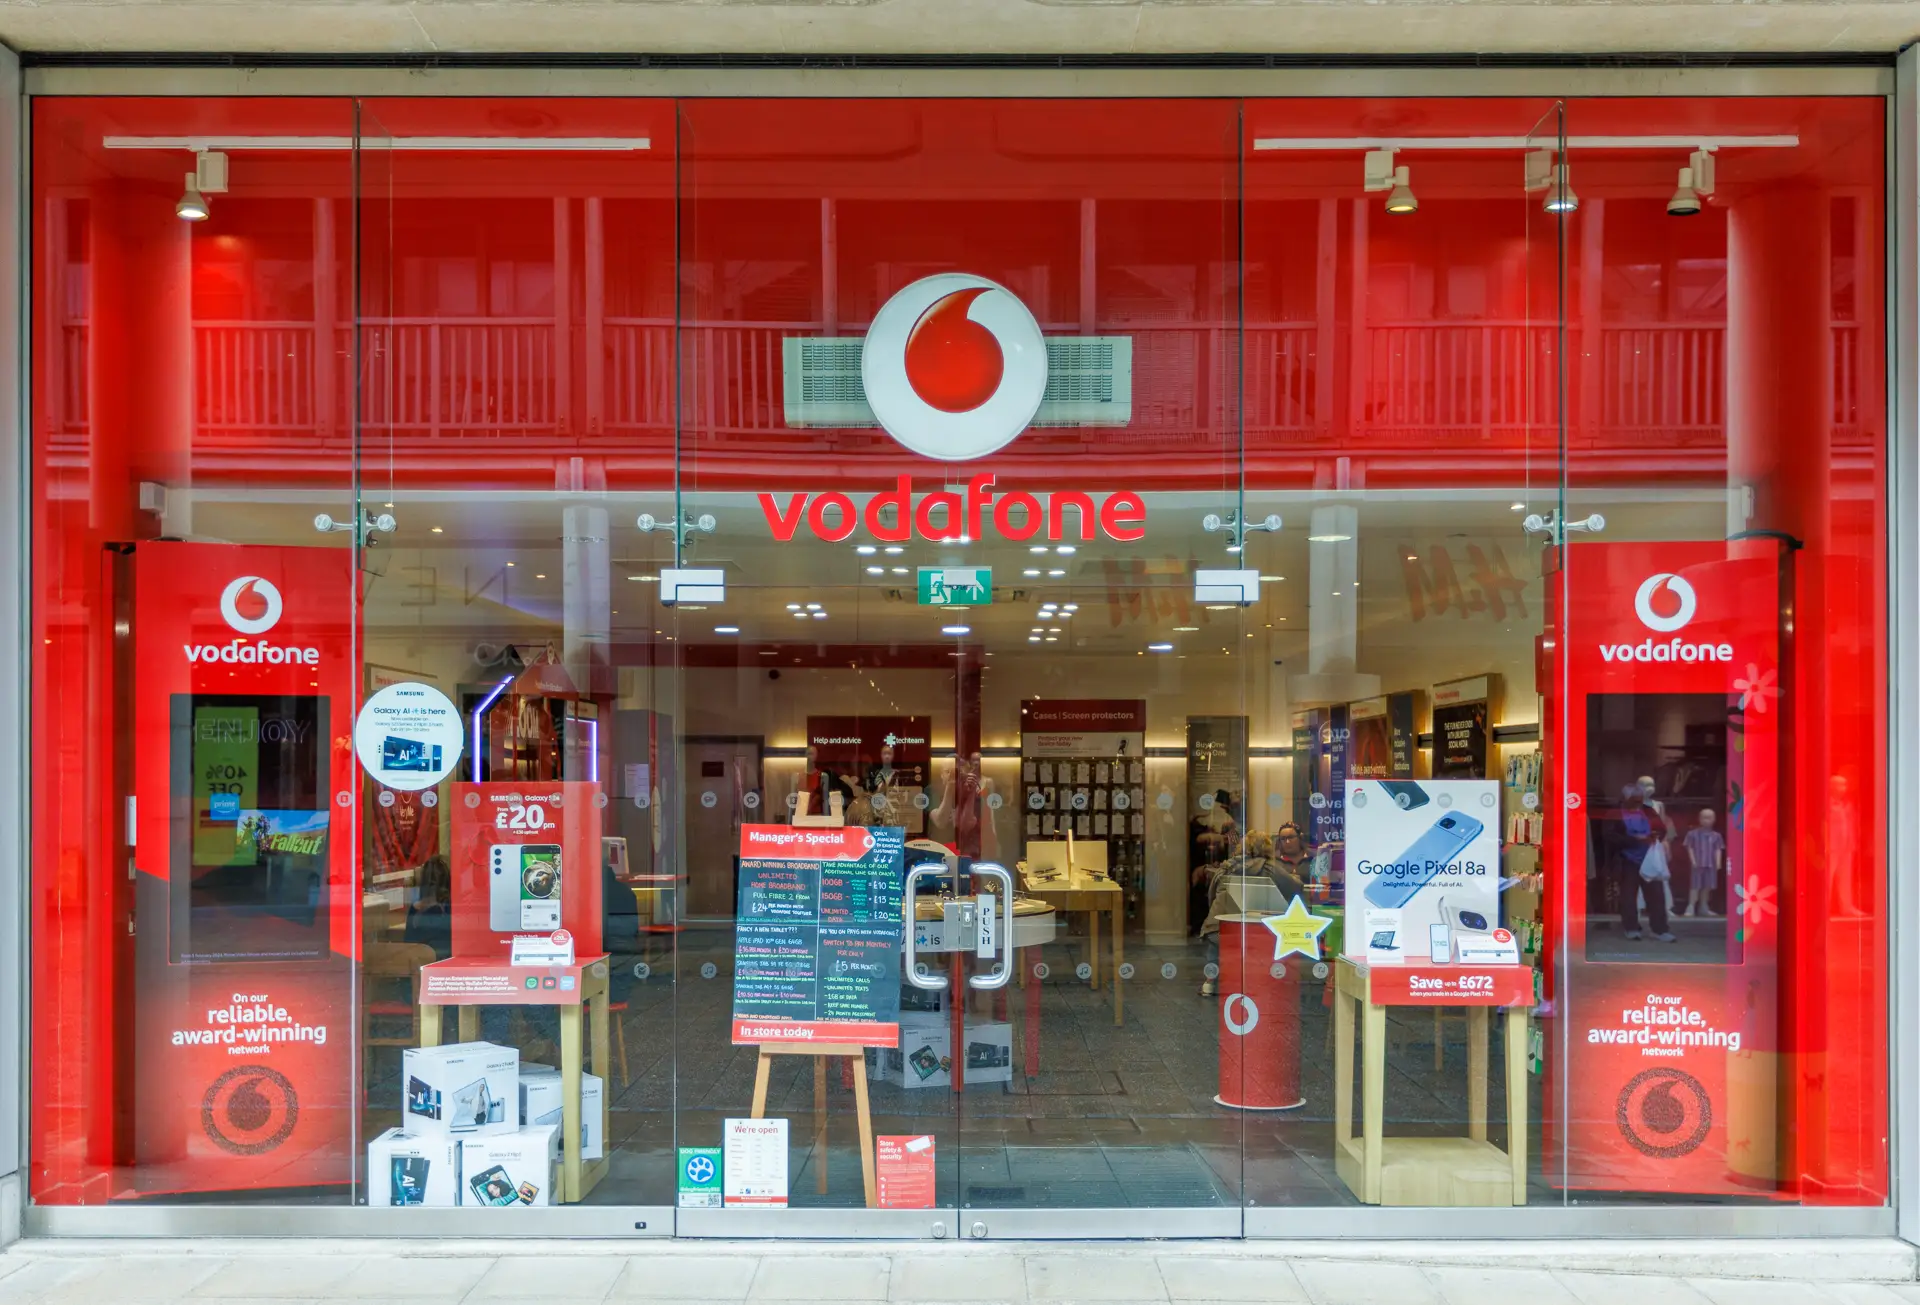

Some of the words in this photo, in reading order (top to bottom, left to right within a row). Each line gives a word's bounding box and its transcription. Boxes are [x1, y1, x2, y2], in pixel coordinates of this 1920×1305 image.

[757, 472, 1146, 542] vodafone
[184, 640, 320, 664] vodafone
[1599, 638, 1732, 662] vodafone
[374, 707, 401, 715] Galaxy
[1092, 712, 1134, 721] protectors
[399, 750, 410, 761] AI
[213, 800, 236, 810] prime
[496, 804, 544, 829] £20
[270, 832, 324, 855] Fallout
[750, 832, 804, 844] Manager's
[806, 833, 844, 845] Special
[1358, 860, 1420, 878] Google
[1425, 861, 1462, 875] Pixel
[1465, 861, 1486, 875] 8a
[873, 881, 887, 890] £10
[752, 902, 768, 913] £24
[874, 911, 888, 919] £20
[982, 907, 990, 945] PUSH
[930, 935, 940, 945] is
[836, 960, 848, 971] £5
[1410, 975, 1442, 989] Save
[1459, 975, 1493, 989] £672
[233, 993, 248, 1003] On
[250, 994, 268, 1002] our
[1647, 994, 1662, 1004] On
[1664, 996, 1682, 1004] our
[208, 1004, 293, 1024] reliable,
[1622, 1006, 1706, 1027] reliable,
[172, 1023, 327, 1045] award-winning
[741, 1026, 751, 1035] In
[753, 1027, 781, 1036] store
[784, 1027, 814, 1039] today
[1588, 1026, 1740, 1051] award-winning
[228, 1044, 270, 1054] network
[1642, 1048, 1684, 1056] network
[417, 1092, 424, 1104] AI
